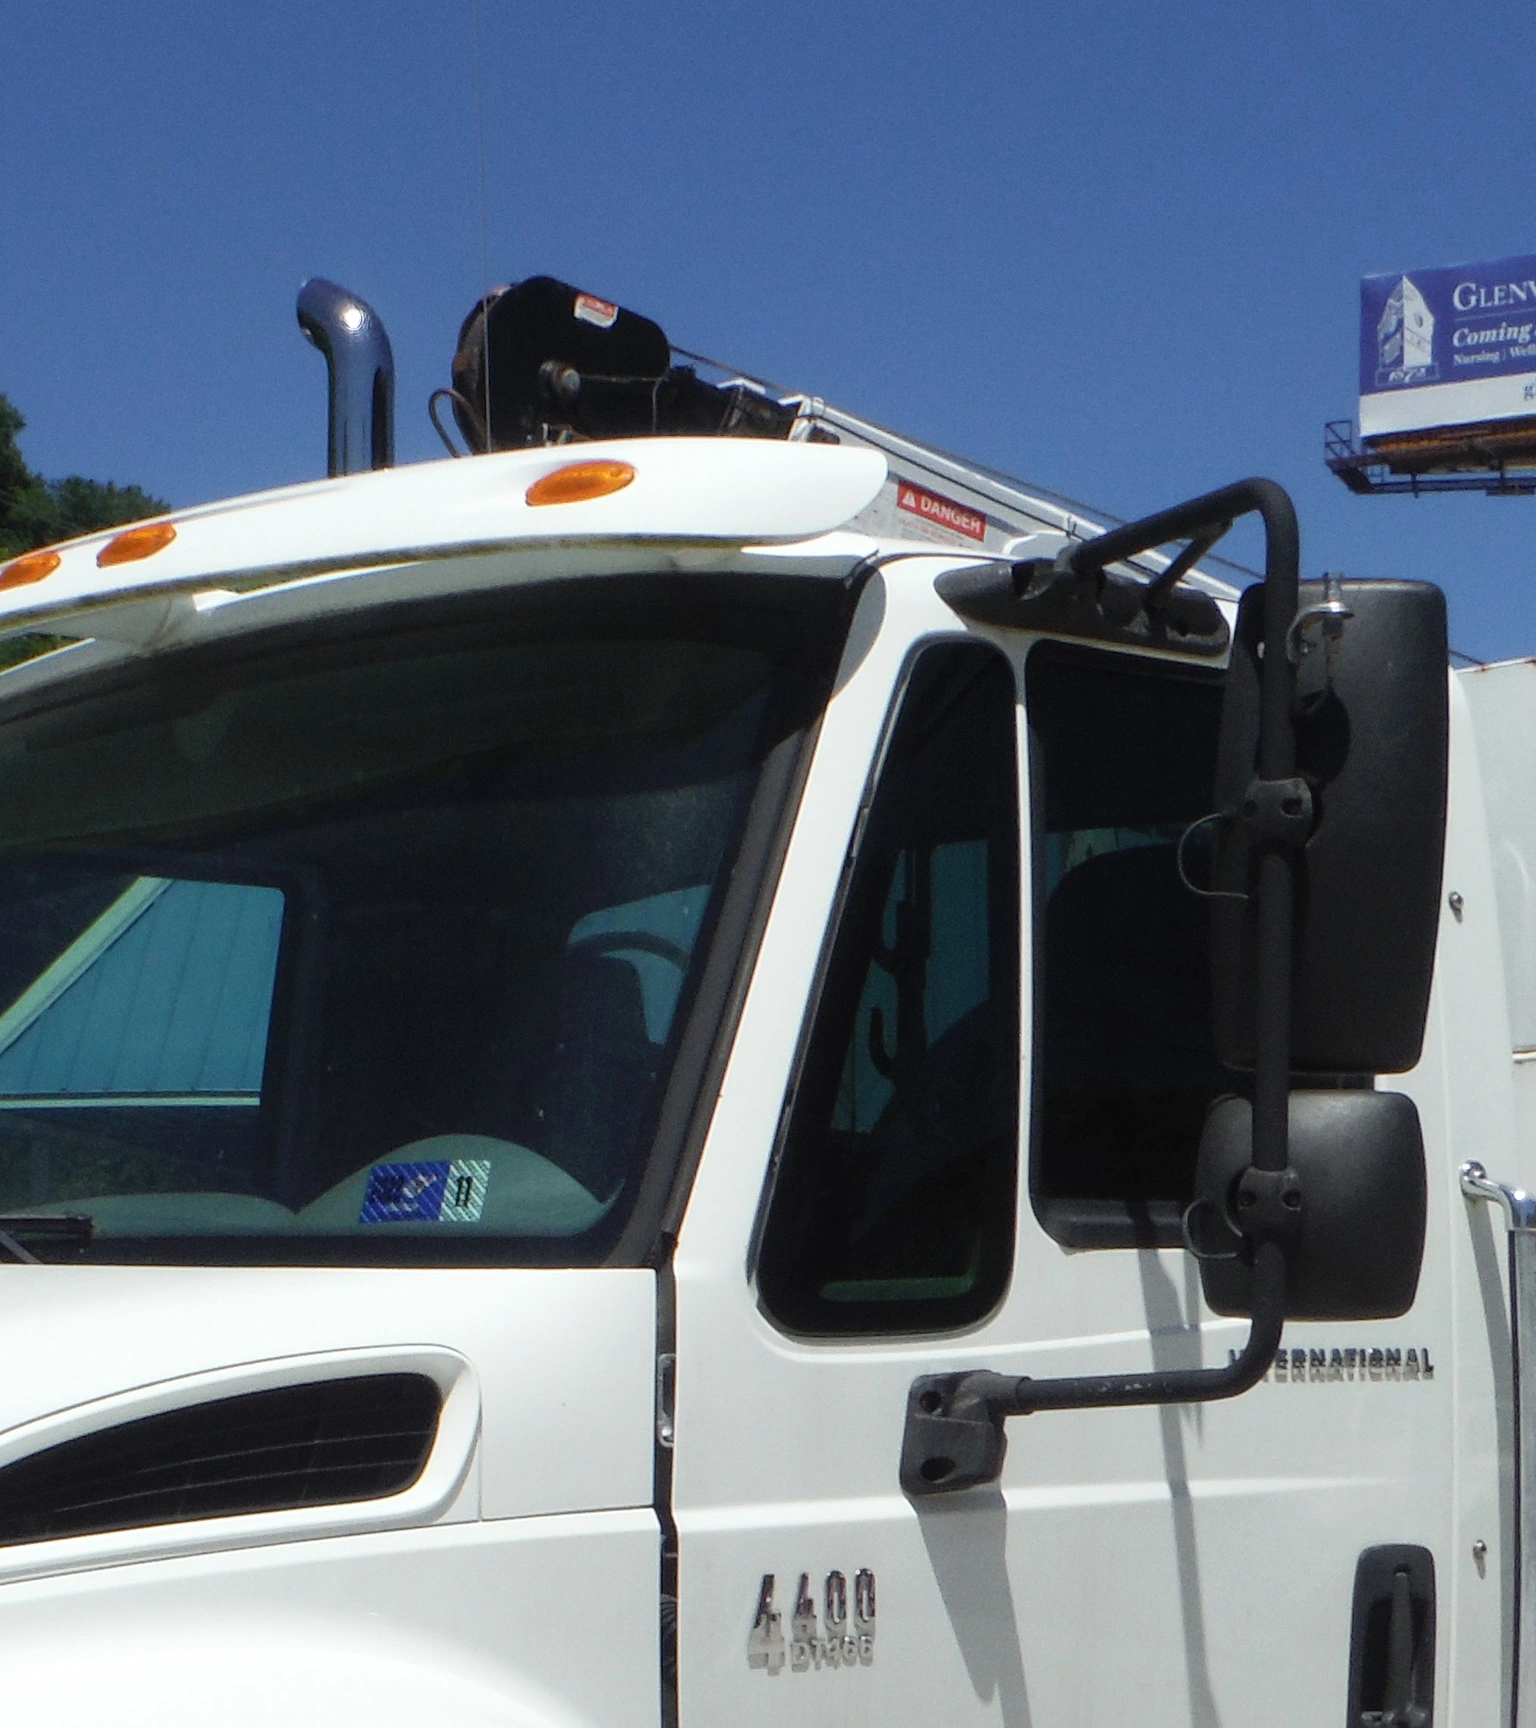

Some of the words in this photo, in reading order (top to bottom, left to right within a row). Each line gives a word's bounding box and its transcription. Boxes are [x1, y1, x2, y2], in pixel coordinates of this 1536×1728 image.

[1452, 321, 1533, 347] Coming
[921, 496, 982, 534] DANGER
[1229, 1347, 1435, 1374] IERNATIONAL
[750, 1568, 877, 1662] 4400
